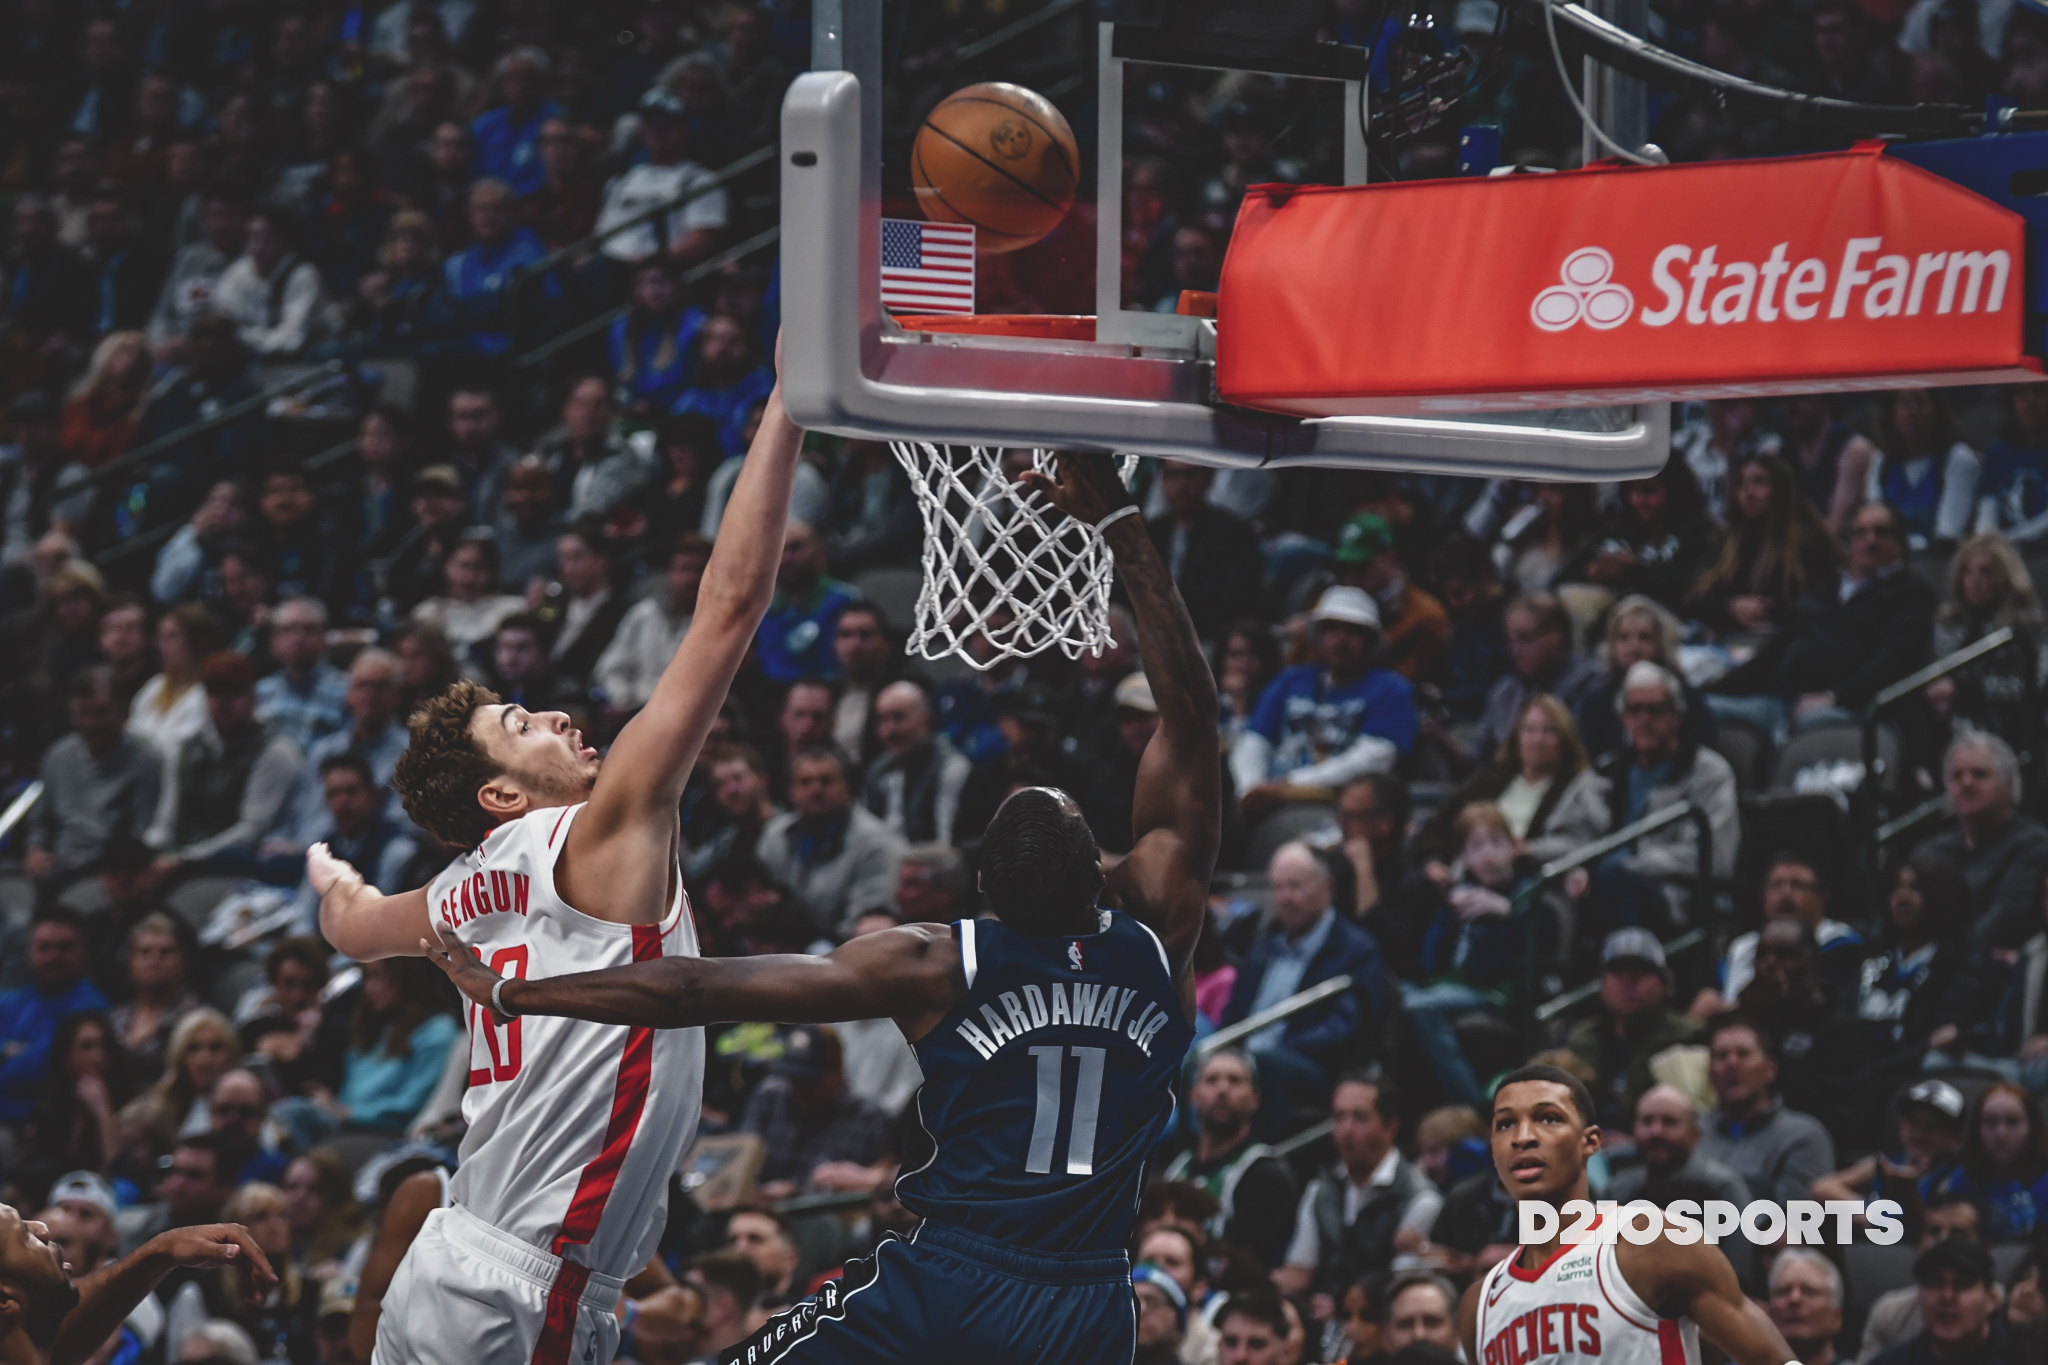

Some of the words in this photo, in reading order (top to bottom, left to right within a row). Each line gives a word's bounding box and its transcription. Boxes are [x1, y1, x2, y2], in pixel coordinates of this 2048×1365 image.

[441, 869, 530, 930] SENGUN
[955, 982, 1139, 1062] HARDAWAY
[1024, 1045, 1107, 1176] 11
[1557, 1269, 1594, 1282] karma
[1561, 1256, 1592, 1271] credit
